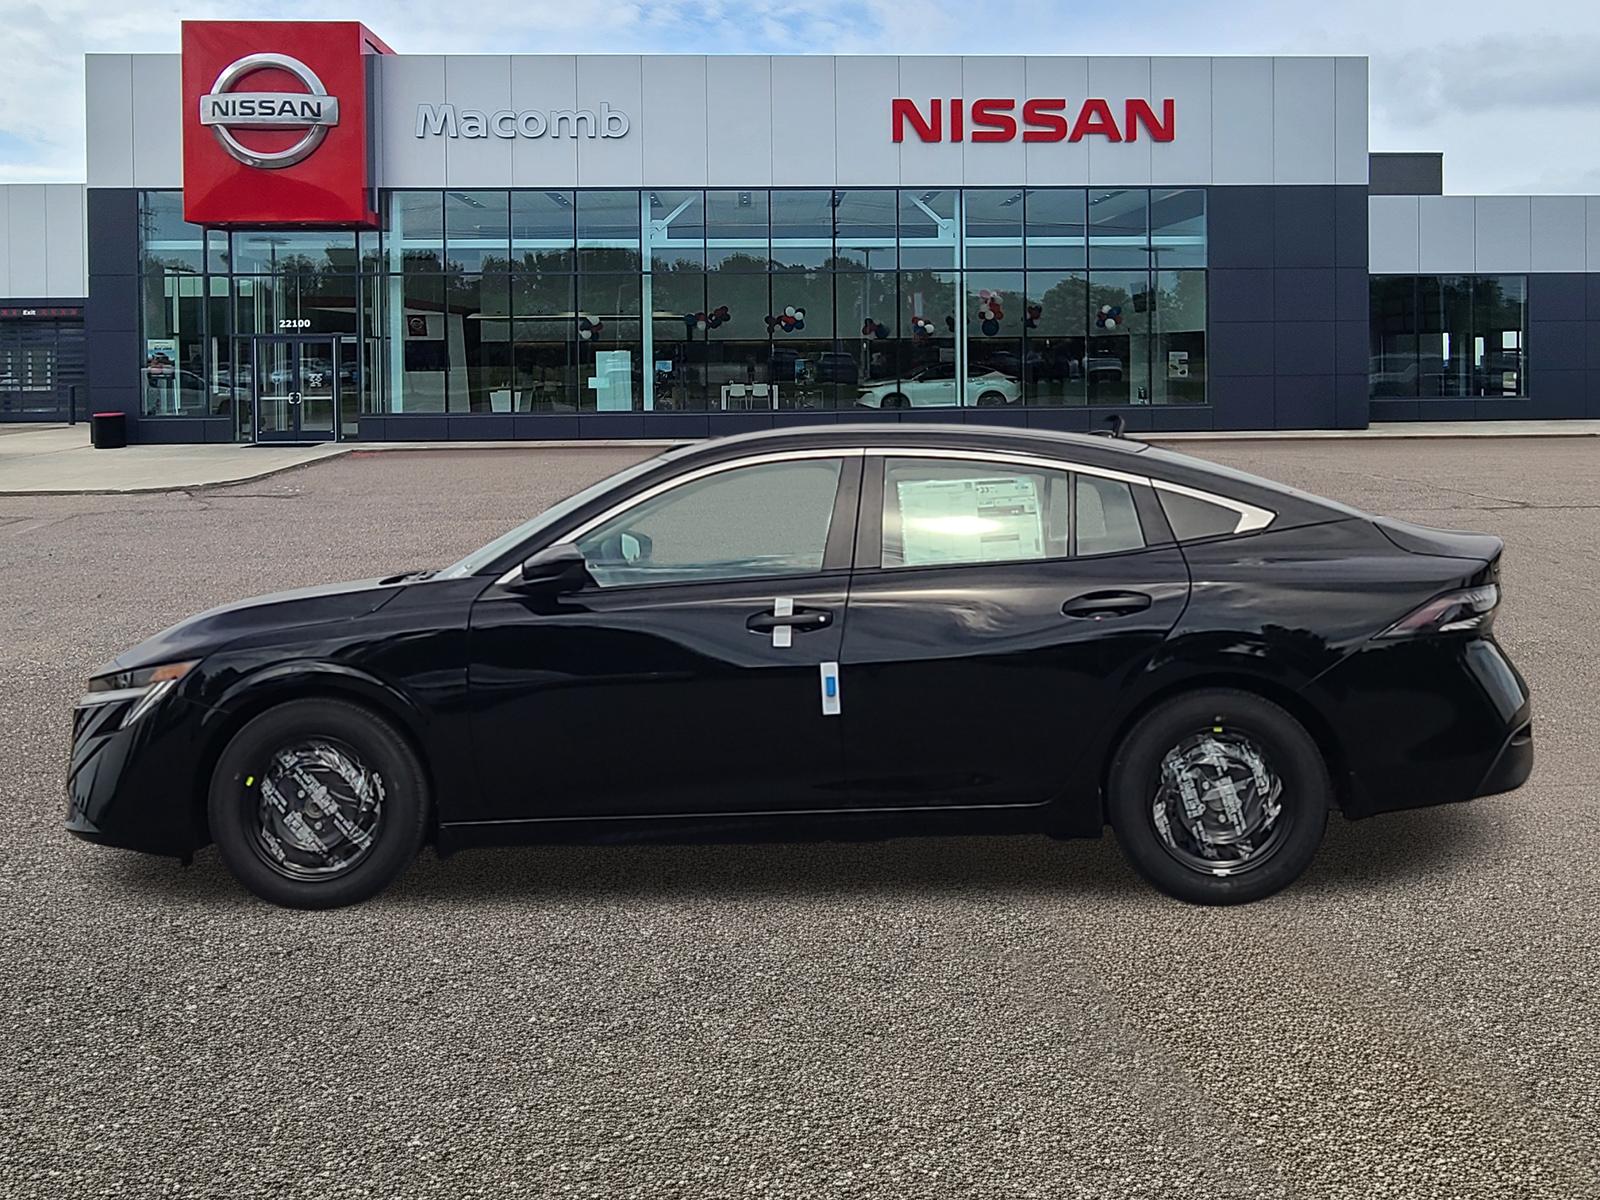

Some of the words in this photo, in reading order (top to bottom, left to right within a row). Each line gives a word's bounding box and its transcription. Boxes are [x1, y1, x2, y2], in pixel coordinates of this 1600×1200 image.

[212, 100, 322, 118] NISSAN
[415, 102, 630, 139] Macomb
[892, 98, 1176, 143] NISSAN
[279, 319, 311, 328] 22100
